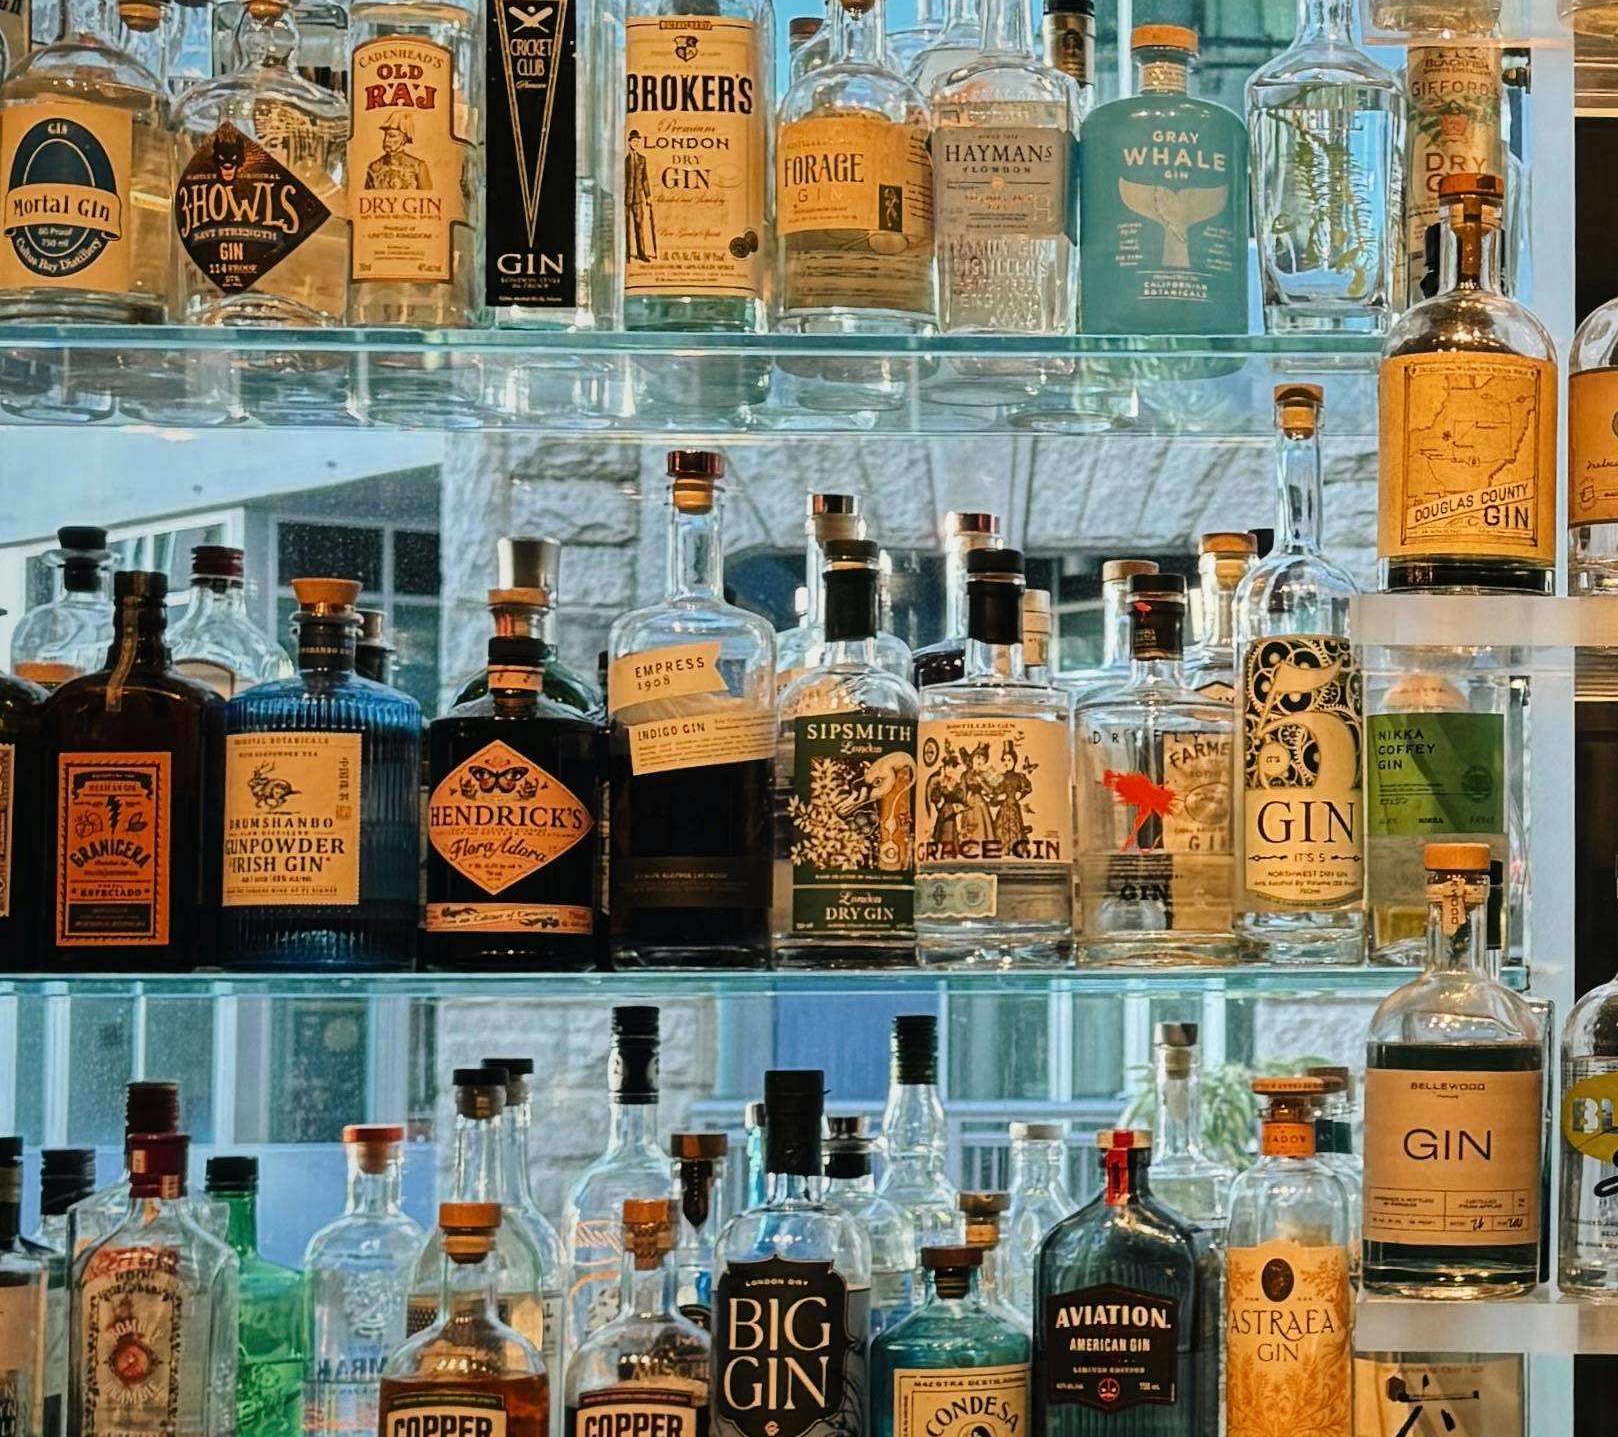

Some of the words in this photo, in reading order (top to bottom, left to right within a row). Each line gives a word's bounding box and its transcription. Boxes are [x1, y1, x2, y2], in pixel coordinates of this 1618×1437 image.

[510, 38, 552, 57] CRICKET
[377, 64, 423, 81] OLD
[517, 58, 545, 77] CLUB
[628, 73, 753, 115] BROKER'S
[643, 135, 729, 150] LONDON
[1153, 130, 1200, 144] GRAY
[672, 154, 701, 165] DRY
[1123, 147, 1226, 172] WHALE
[1425, 152, 1487, 173] DRY
[661, 167, 710, 190] GIN
[784, 153, 864, 188] FORAGE
[1165, 170, 1188, 180] GIN
[13, 194, 69, 215] Mortal
[77, 197, 110, 222] Gin
[360, 197, 395, 214] DRY
[402, 197, 441, 214] GIN
[220, 242, 243, 260] GIN
[497, 253, 564, 276] GIN
[1414, 494, 1474, 523] DOUGLAS
[1480, 483, 1530, 507] COUNTY
[1483, 503, 1530, 531] GIN
[635, 657, 705, 679] EMPRESS
[637, 675, 671, 691] 1908
[637, 725, 677, 742] INDIGO
[682, 721, 705, 736] GIN
[807, 723, 911, 743] SIPSMITH
[1378, 729, 1425, 741] NIKKA
[841, 741, 883, 754] London
[1378, 744, 1436, 756] COFFEY
[1378, 759, 1403, 770] GIN
[229, 817, 333, 830] DRUMSHANBO
[430, 805, 582, 829] HENDRICK'S
[1257, 799, 1355, 844] GIN
[70, 838, 150, 868] GRANICERA
[225, 837, 345, 855] GUNPOWDER
[232, 856, 277, 874] IRISH
[284, 856, 323, 873] GIN
[1294, 853, 1315, 863] IT'S
[1319, 853, 1326, 863] 5
[80, 888, 141, 898] ESPECIADO
[839, 891, 883, 905] London
[826, 906, 860, 922] DRY
[864, 906, 894, 921] GIN
[1411, 1081, 1486, 1090] BELLEWOOD
[1403, 1128, 1492, 1161] GIN
[728, 1297, 831, 1352] BIG
[1231, 1309, 1335, 1341] ASTRAEA
[1070, 1337, 1123, 1352] AMERICAN
[1126, 1338, 1151, 1352] GIN
[1257, 1343, 1299, 1362] GIN
[723, 1355, 830, 1410] GIN
